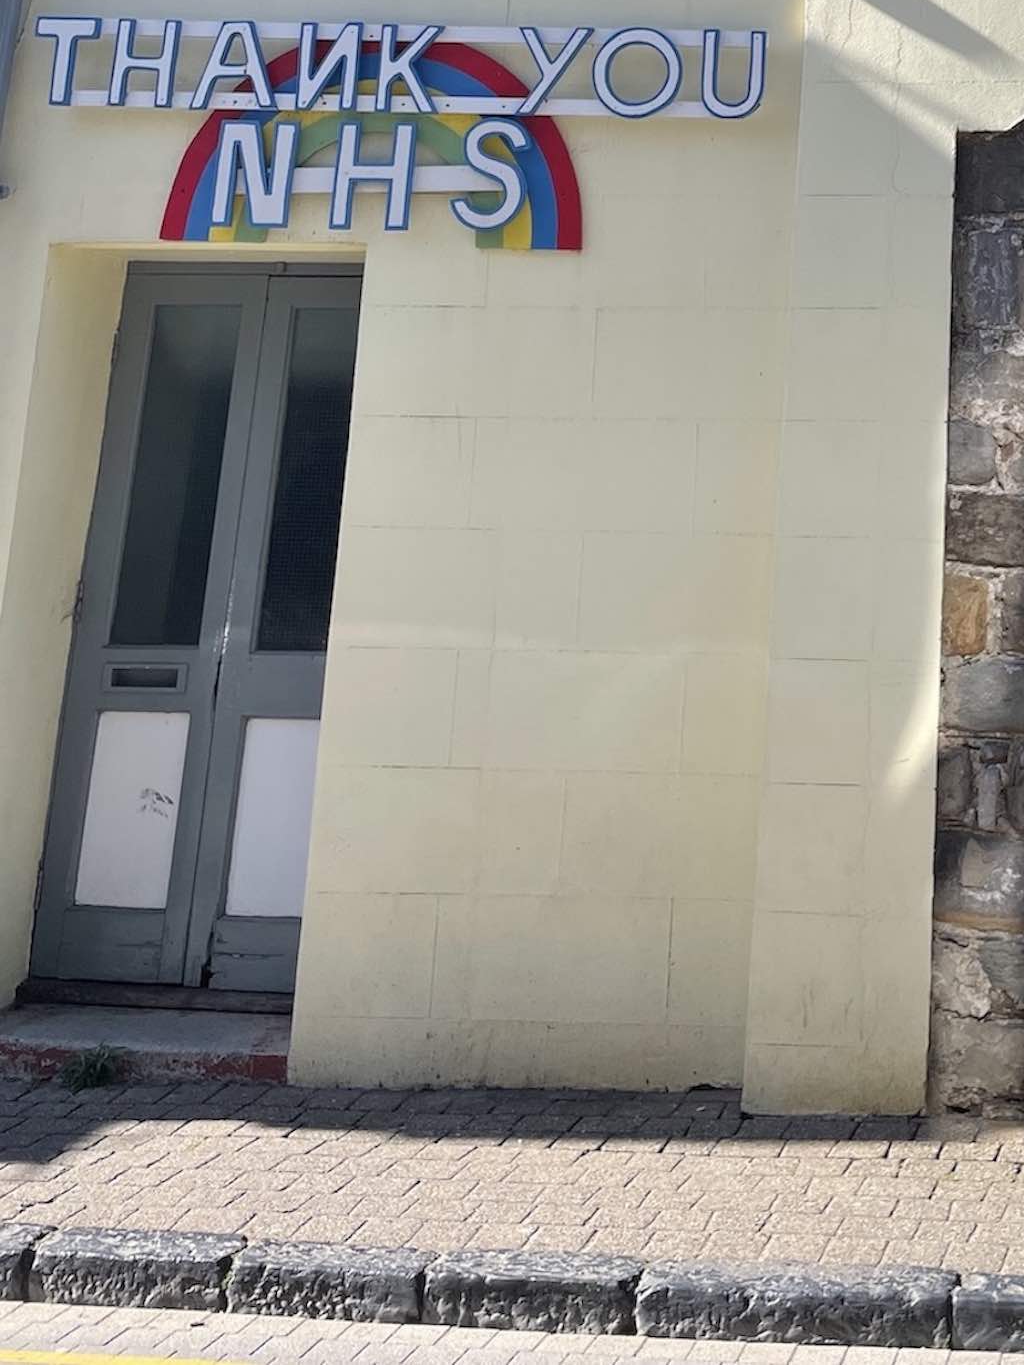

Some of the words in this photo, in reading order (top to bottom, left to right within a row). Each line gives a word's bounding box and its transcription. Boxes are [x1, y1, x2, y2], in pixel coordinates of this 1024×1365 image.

[37, 16, 444, 114] THANK
[517, 26, 767, 120] YOU
[212, 116, 530, 232] NHS
